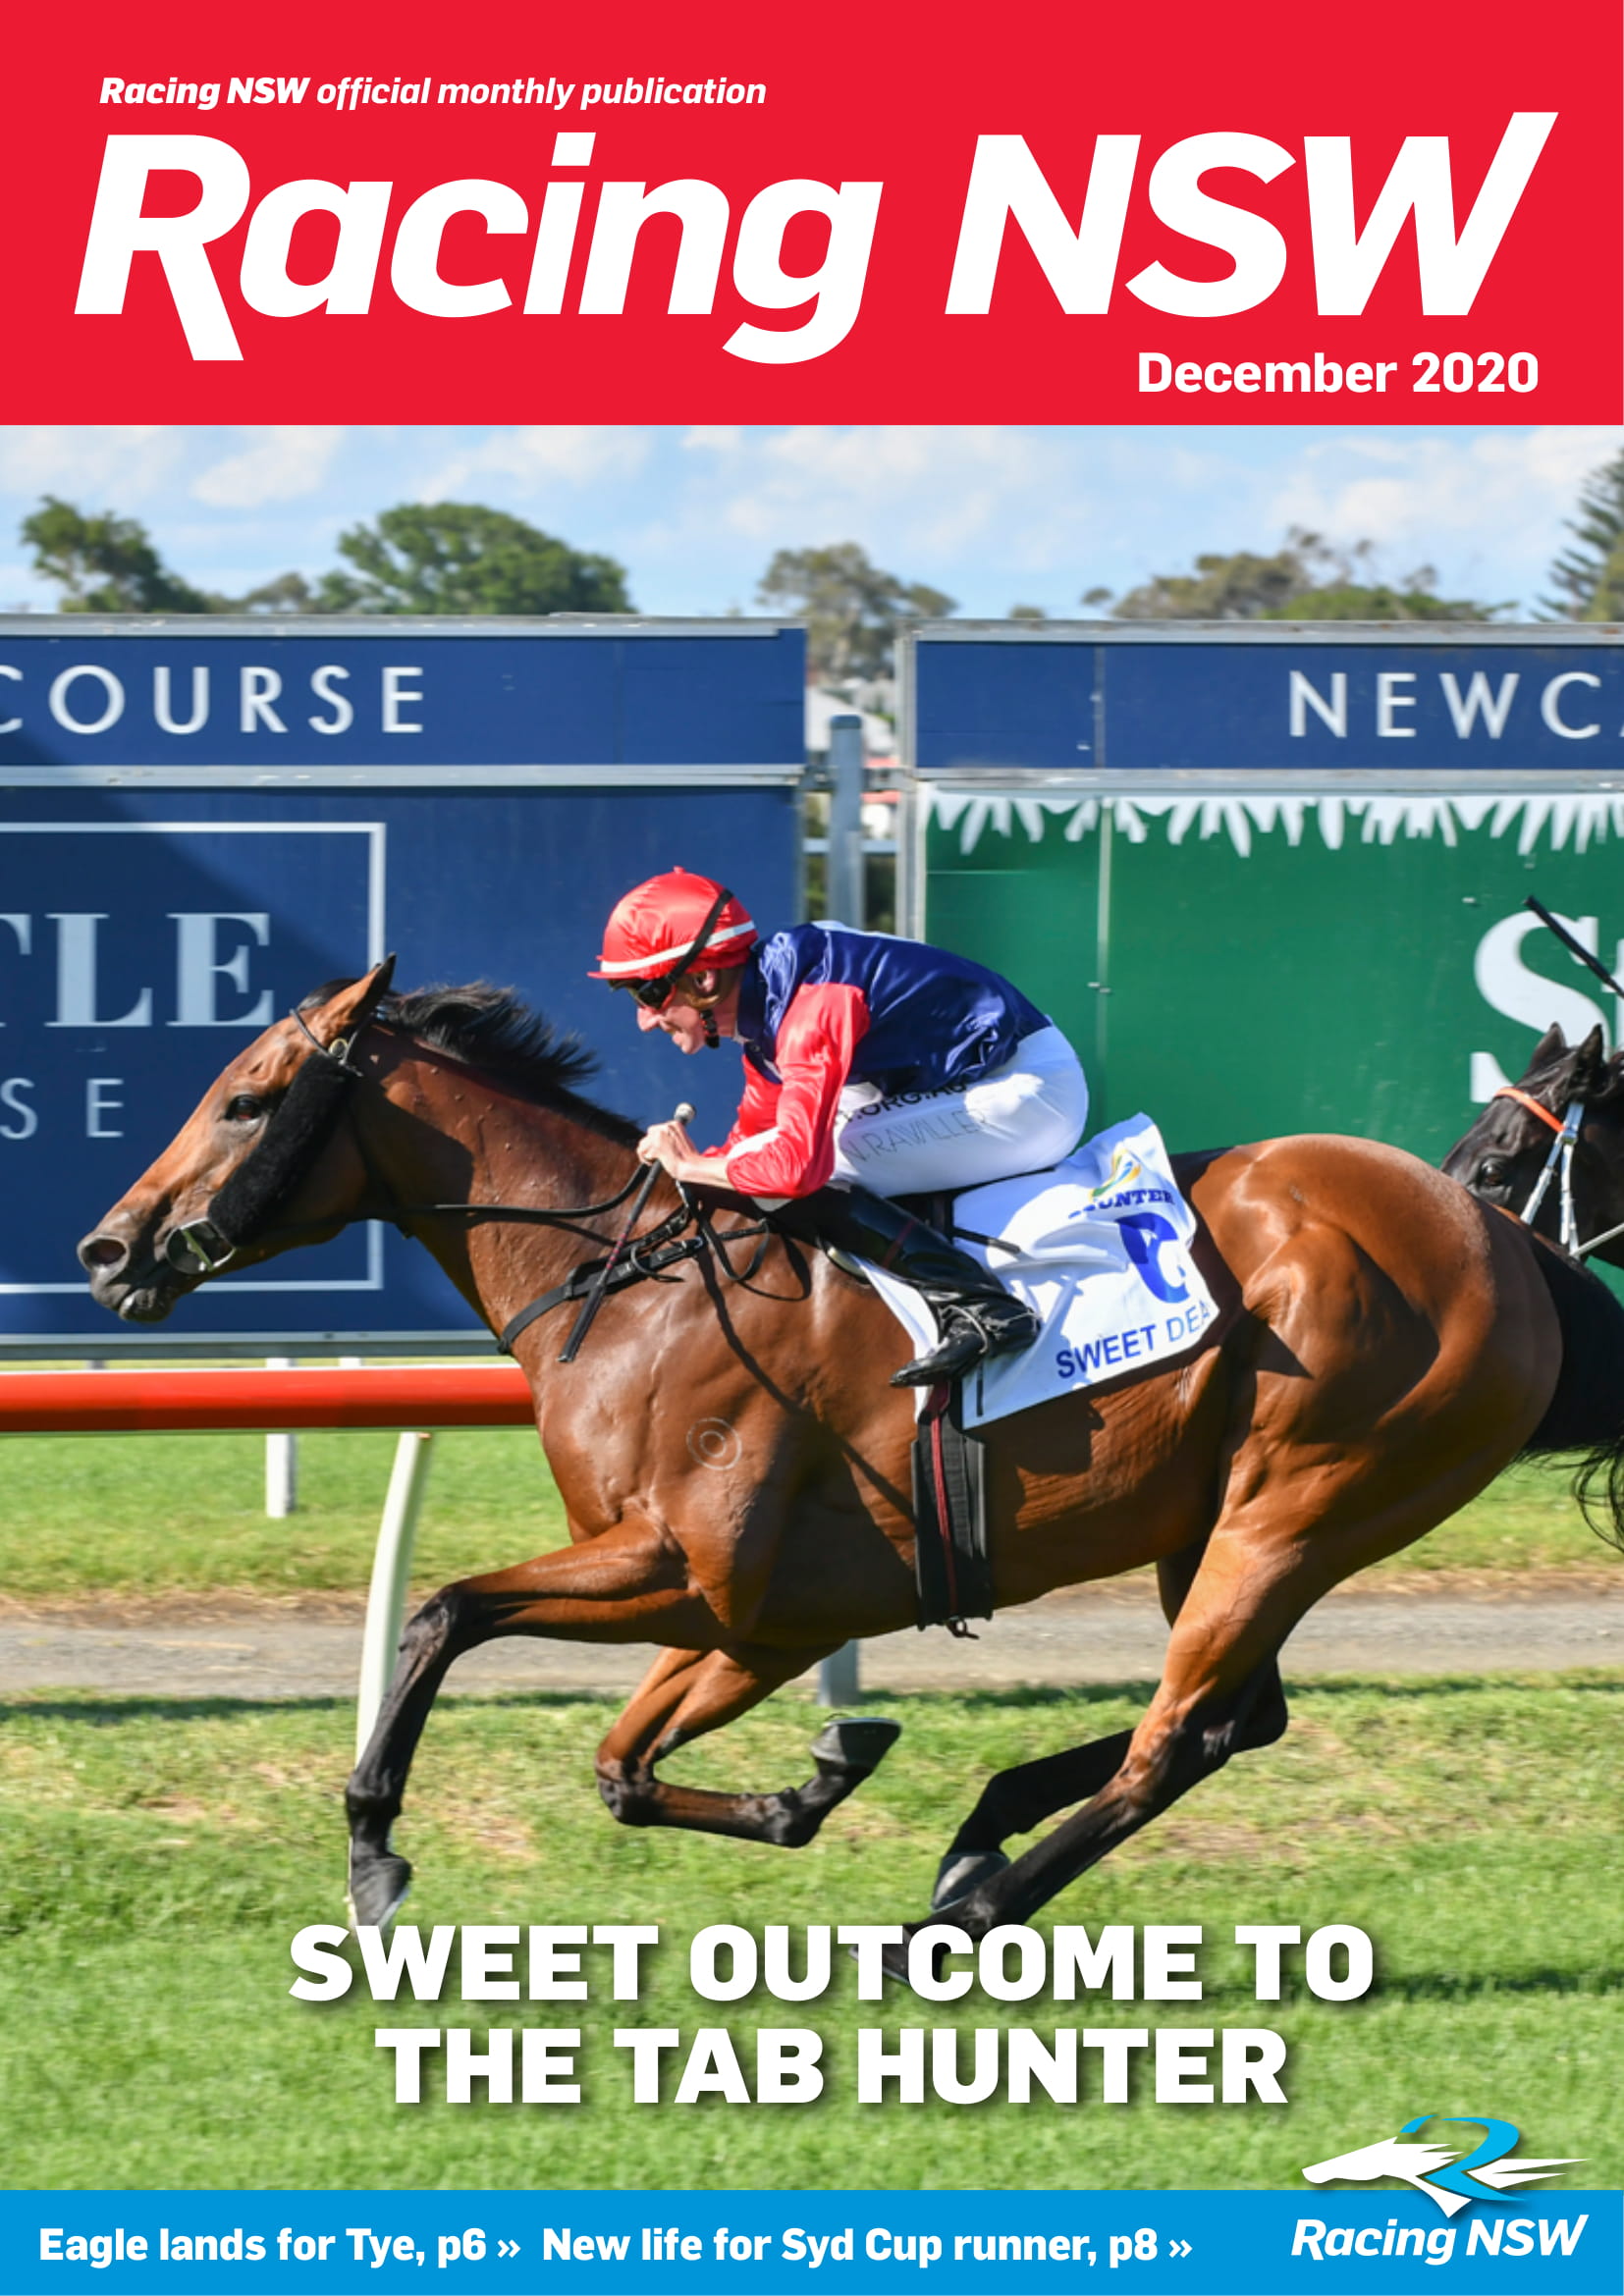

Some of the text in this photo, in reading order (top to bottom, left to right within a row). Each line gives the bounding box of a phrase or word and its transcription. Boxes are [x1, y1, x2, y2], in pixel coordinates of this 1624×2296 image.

[1289, 671, 1624, 738] NEWC
[1471, 910, 1624, 1103] S
[1068, 1188, 1175, 1219] UNTER
[1056, 1324, 1157, 1378] SWEET
